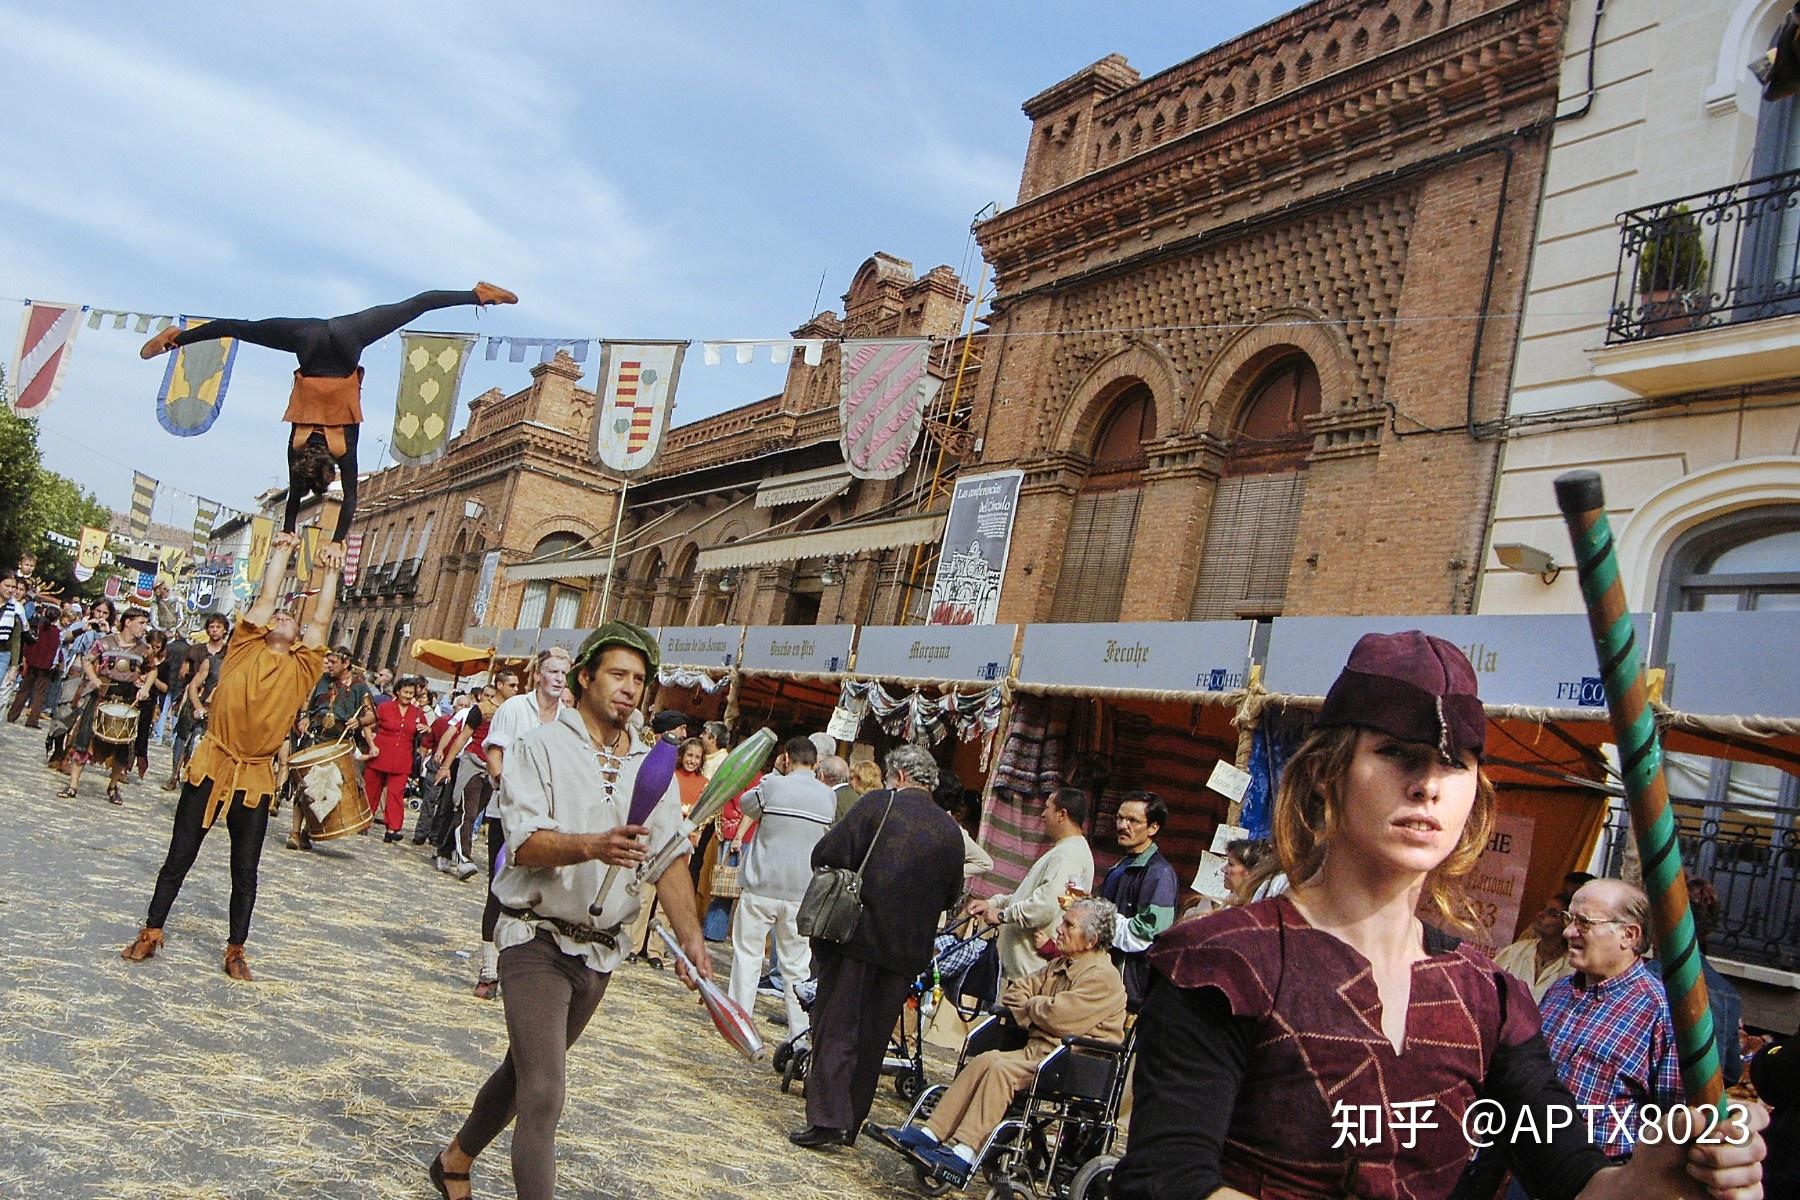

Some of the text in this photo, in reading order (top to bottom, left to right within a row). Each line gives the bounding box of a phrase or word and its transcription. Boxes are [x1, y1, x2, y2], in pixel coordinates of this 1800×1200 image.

[909, 641, 951, 663] Morgana
[1196, 669, 1242, 691] FECOHE
[1557, 677, 1606, 706] FECO
